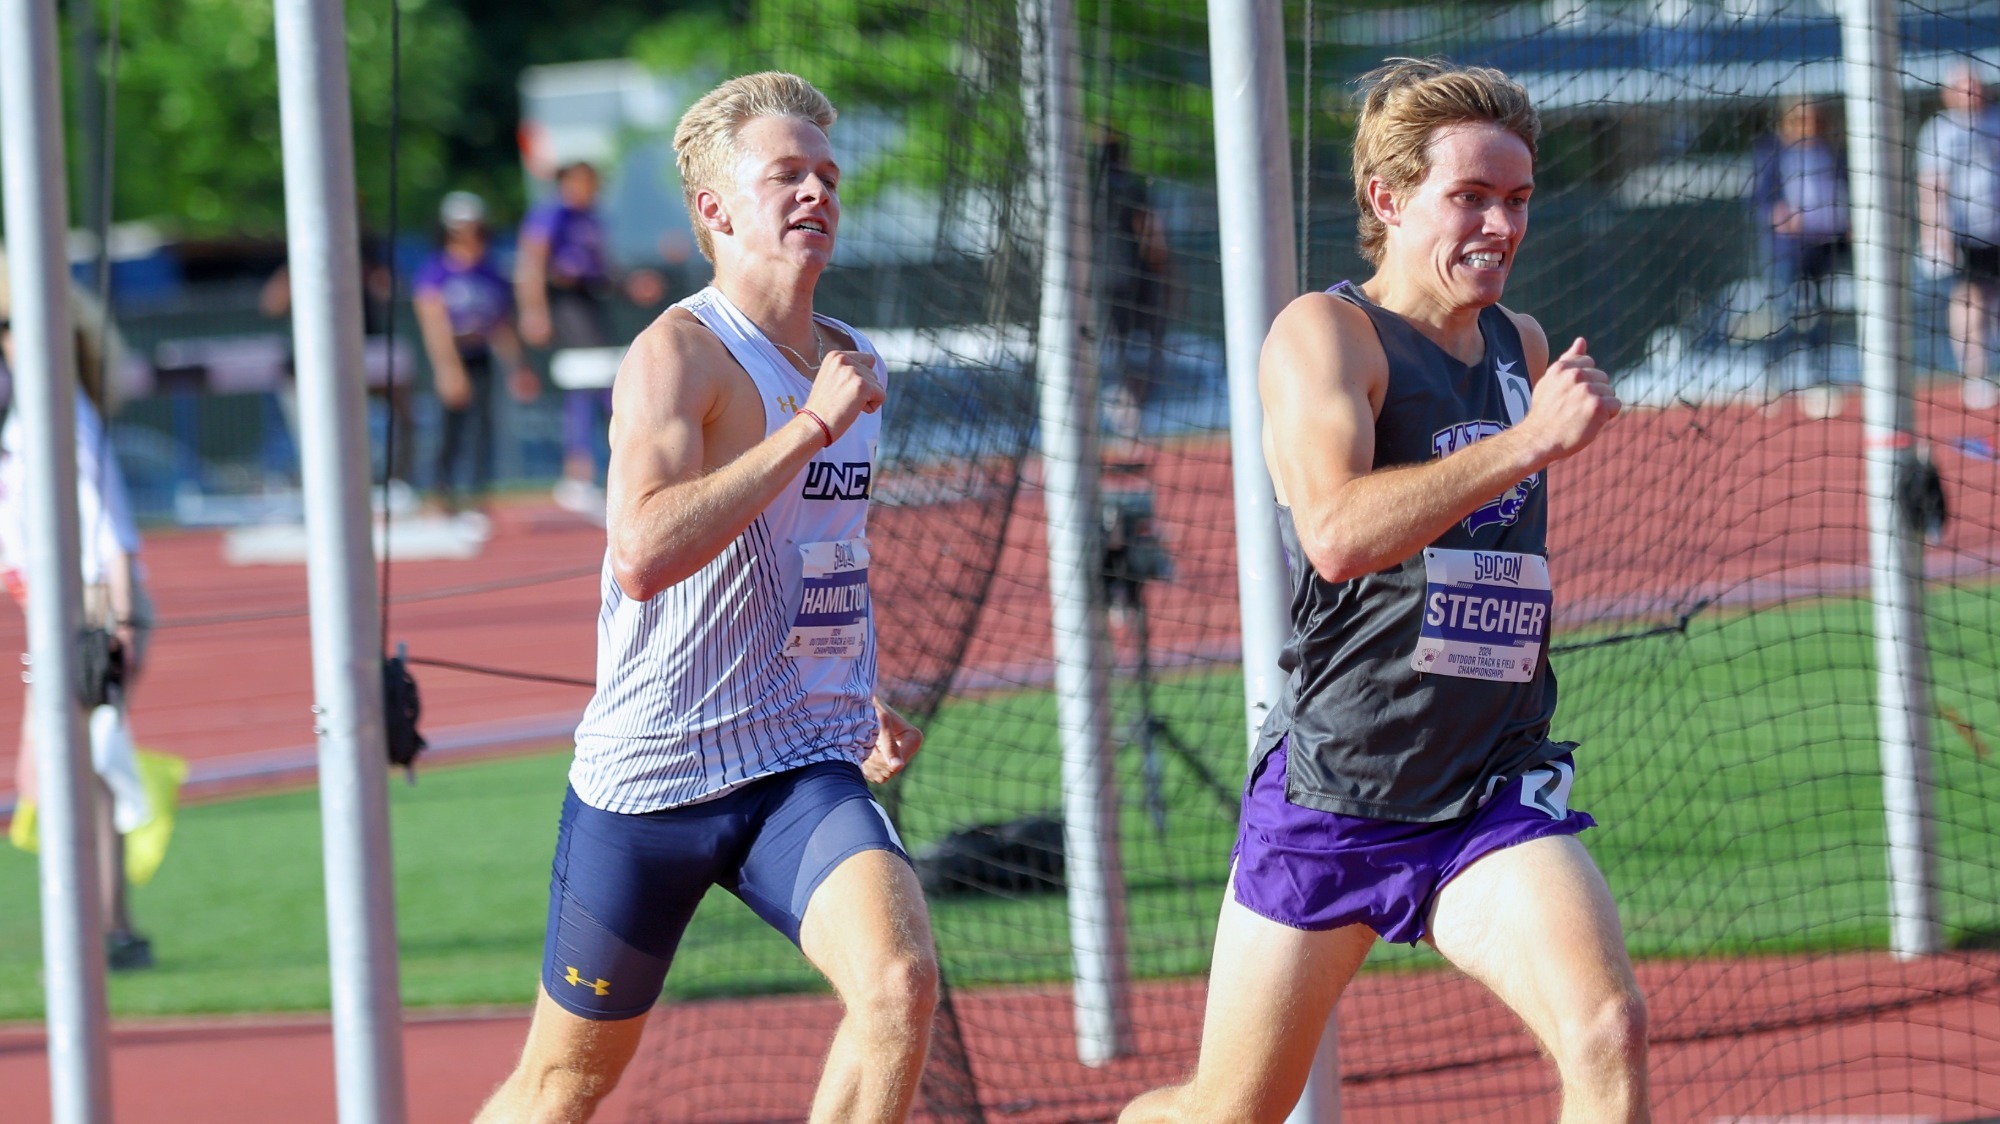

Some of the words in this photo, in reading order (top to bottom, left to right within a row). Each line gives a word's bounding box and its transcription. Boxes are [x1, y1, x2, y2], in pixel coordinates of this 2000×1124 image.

[803, 462, 871, 500] UNC
[801, 583, 867, 615] HAMILTON
[1426, 591, 1546, 636] STECHER
[1448, 653, 1476, 665] OUTDOOR
[1477, 657, 1495, 668] TRACK
[1501, 660, 1515, 669] FIELD
[1478, 646, 1492, 657] 2024
[1457, 665, 1504, 679] CHAMPIONSHIPS
